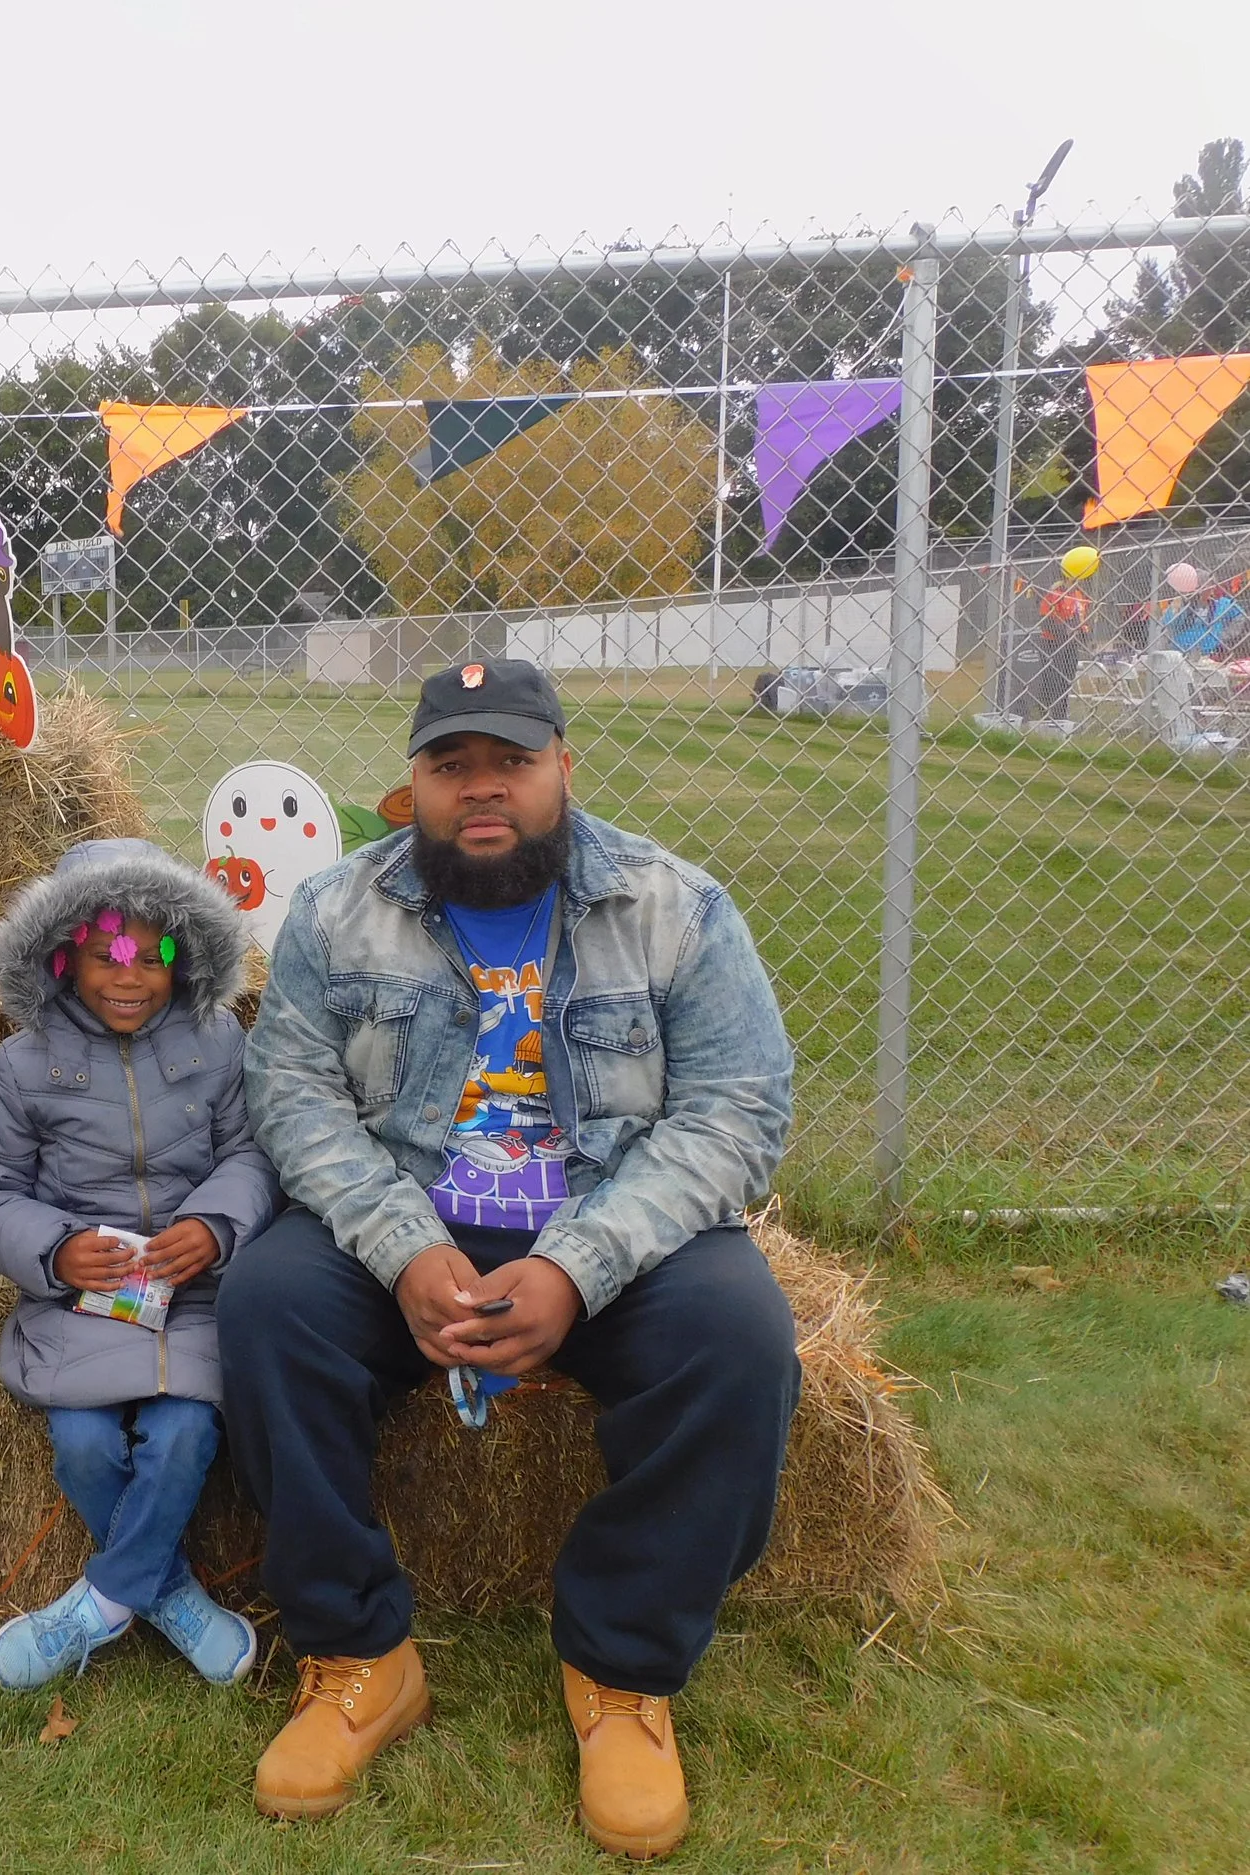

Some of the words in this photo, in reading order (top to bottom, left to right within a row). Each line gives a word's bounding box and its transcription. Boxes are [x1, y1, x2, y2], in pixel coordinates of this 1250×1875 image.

[56, 542, 71, 551] LEE
[78, 538, 102, 547] FIELD
[186, 1104, 197, 1112] CK
